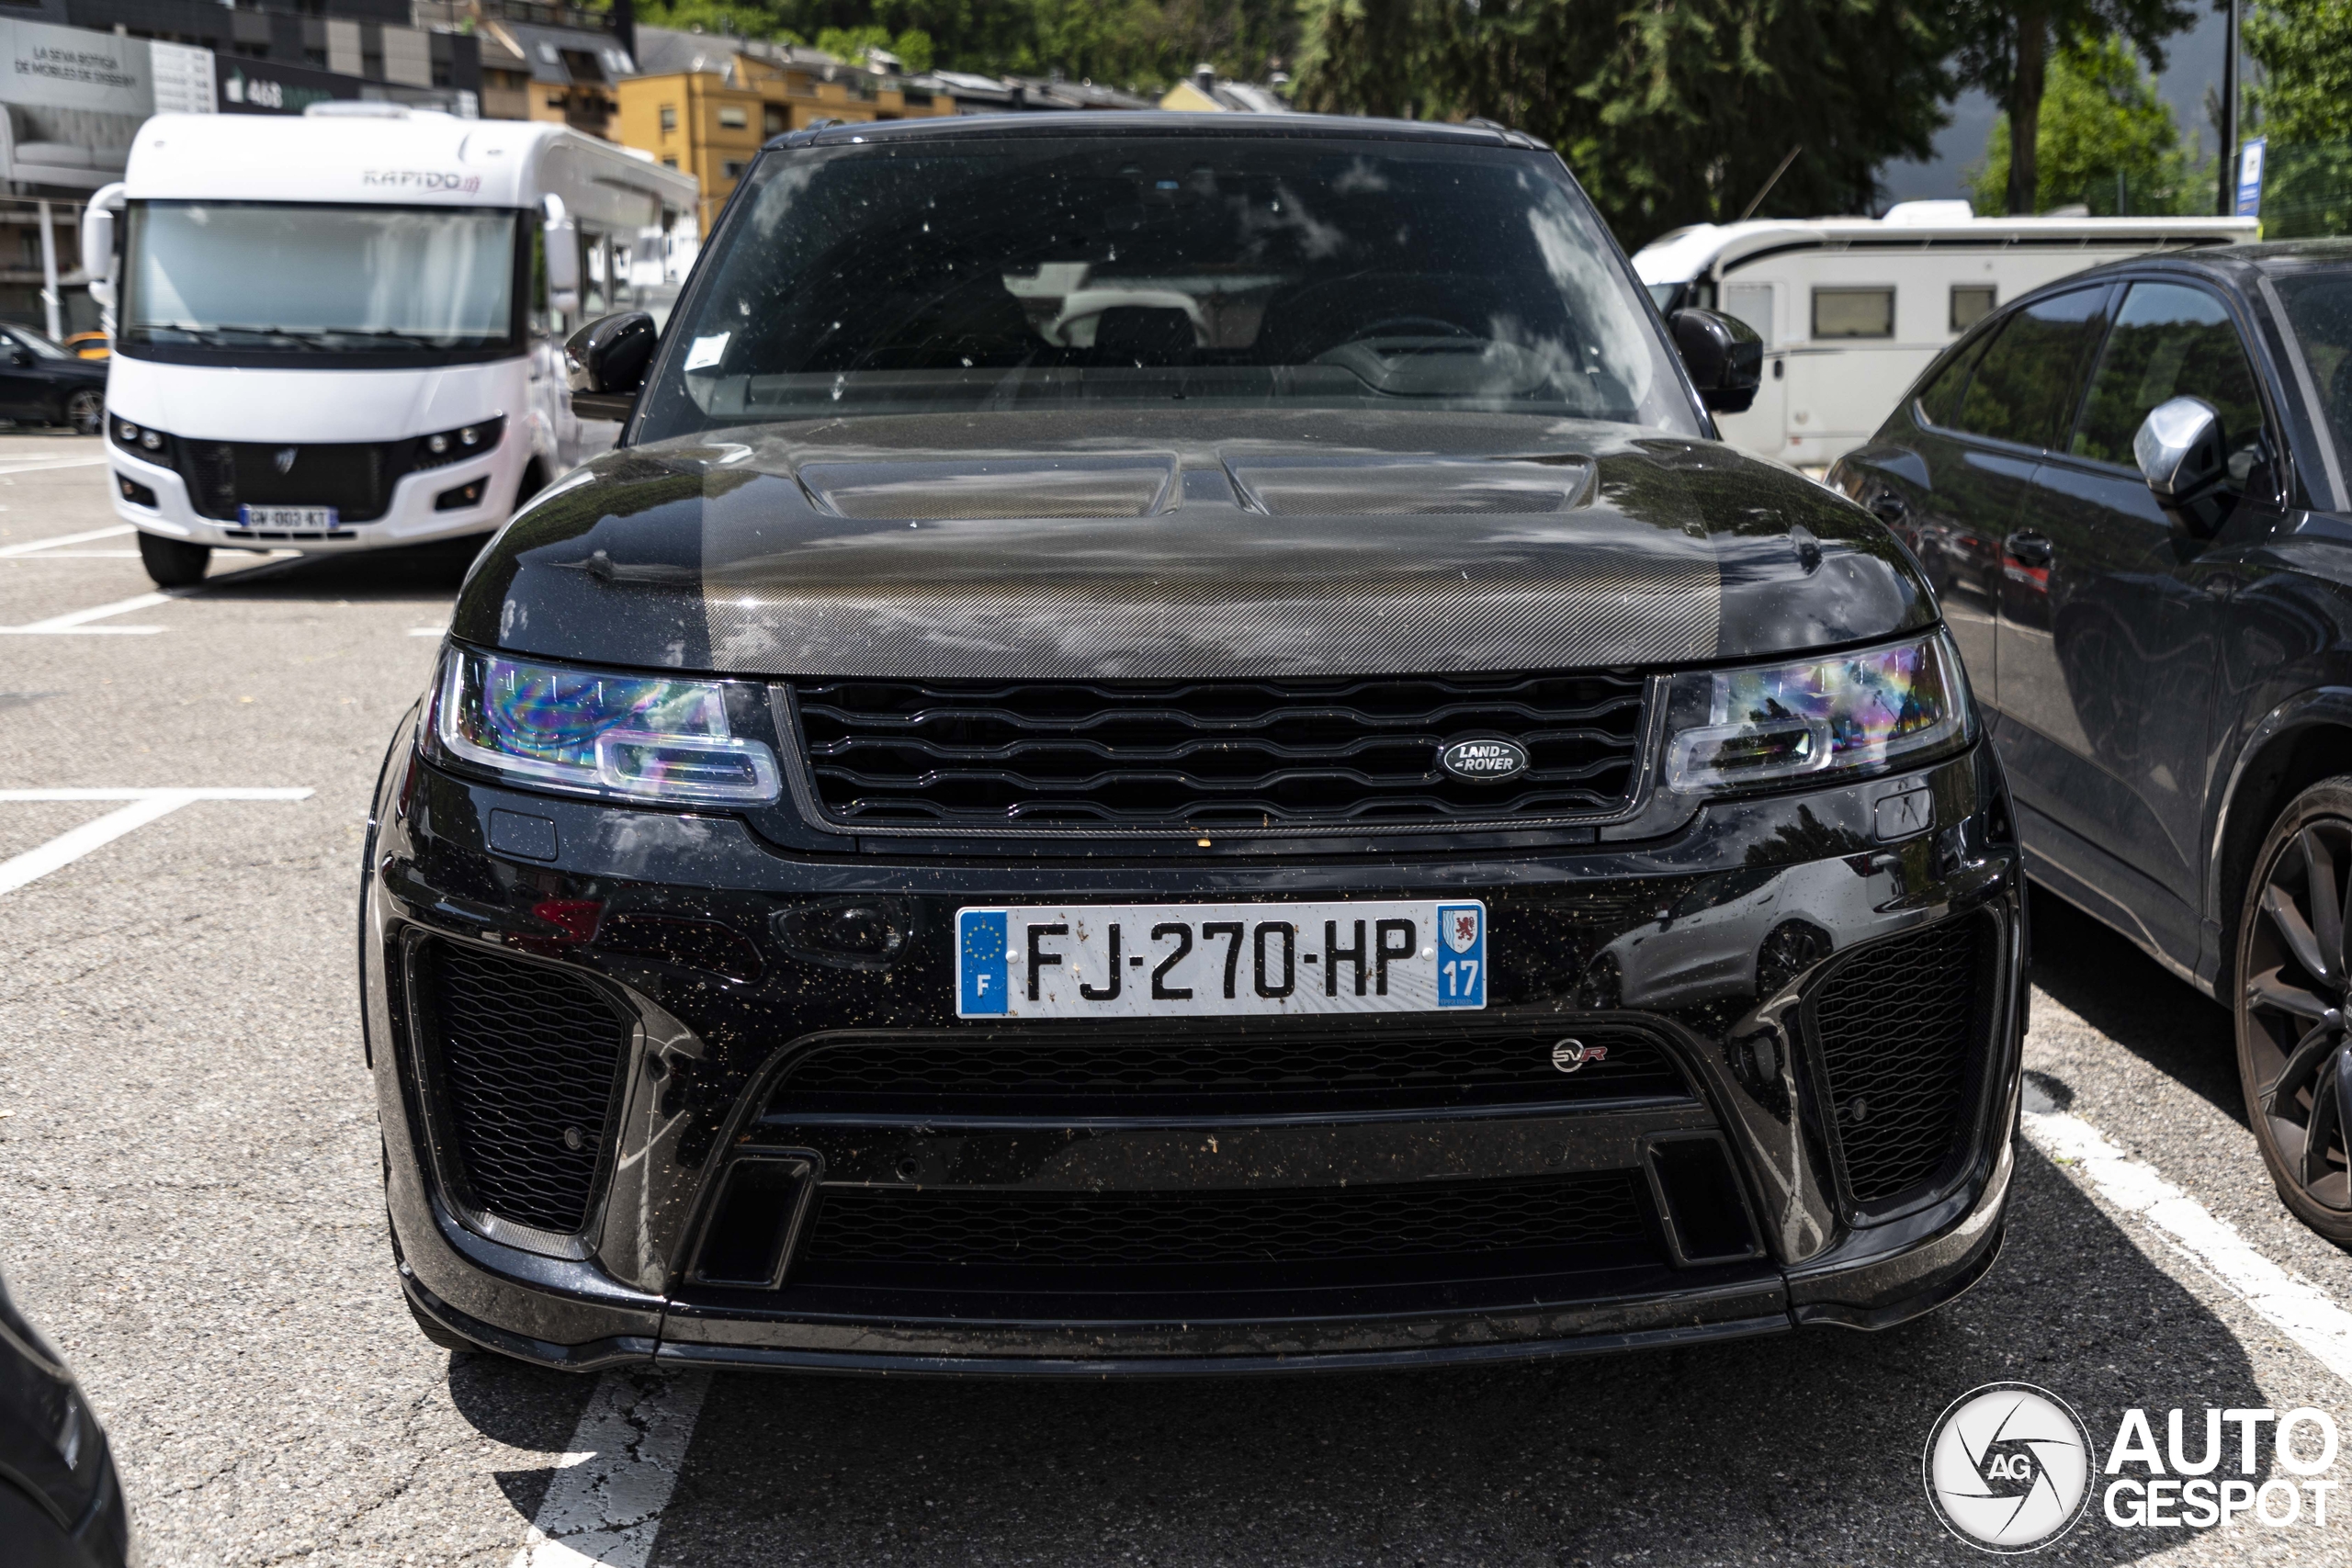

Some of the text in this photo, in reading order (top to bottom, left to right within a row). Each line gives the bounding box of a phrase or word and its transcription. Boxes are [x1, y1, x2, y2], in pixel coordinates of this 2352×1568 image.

[364, 171, 460, 189] RAPIDO
[1027, 919, 1417, 1001] FJ-270-HP
[977, 974, 991, 997] F
[1442, 960, 1478, 996] 17
[1552, 1045, 1608, 1063] SVR
